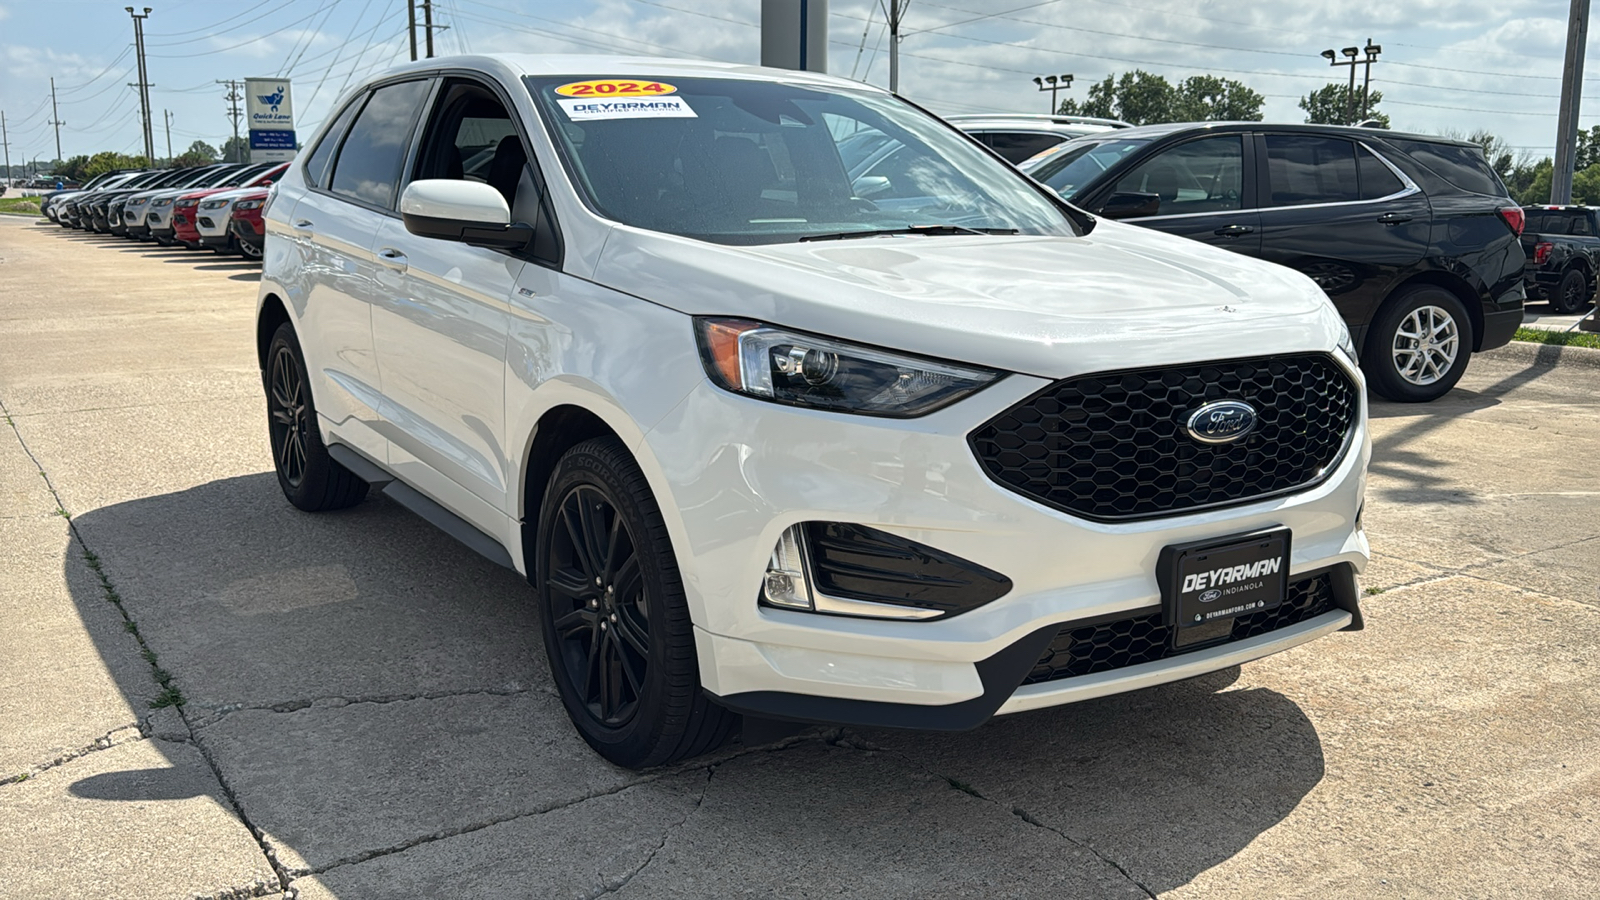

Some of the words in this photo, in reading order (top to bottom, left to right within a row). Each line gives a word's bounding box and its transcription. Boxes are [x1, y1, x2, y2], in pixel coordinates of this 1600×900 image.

[571, 83, 665, 95] 2024
[573, 102, 680, 112] DEYARMAN
[1207, 410, 1244, 434] Ford
[1182, 557, 1282, 593] DEYARMAN
[1223, 582, 1263, 595] INDIANOLA
[1206, 602, 1255, 618] DEYARMANFORD.COM
